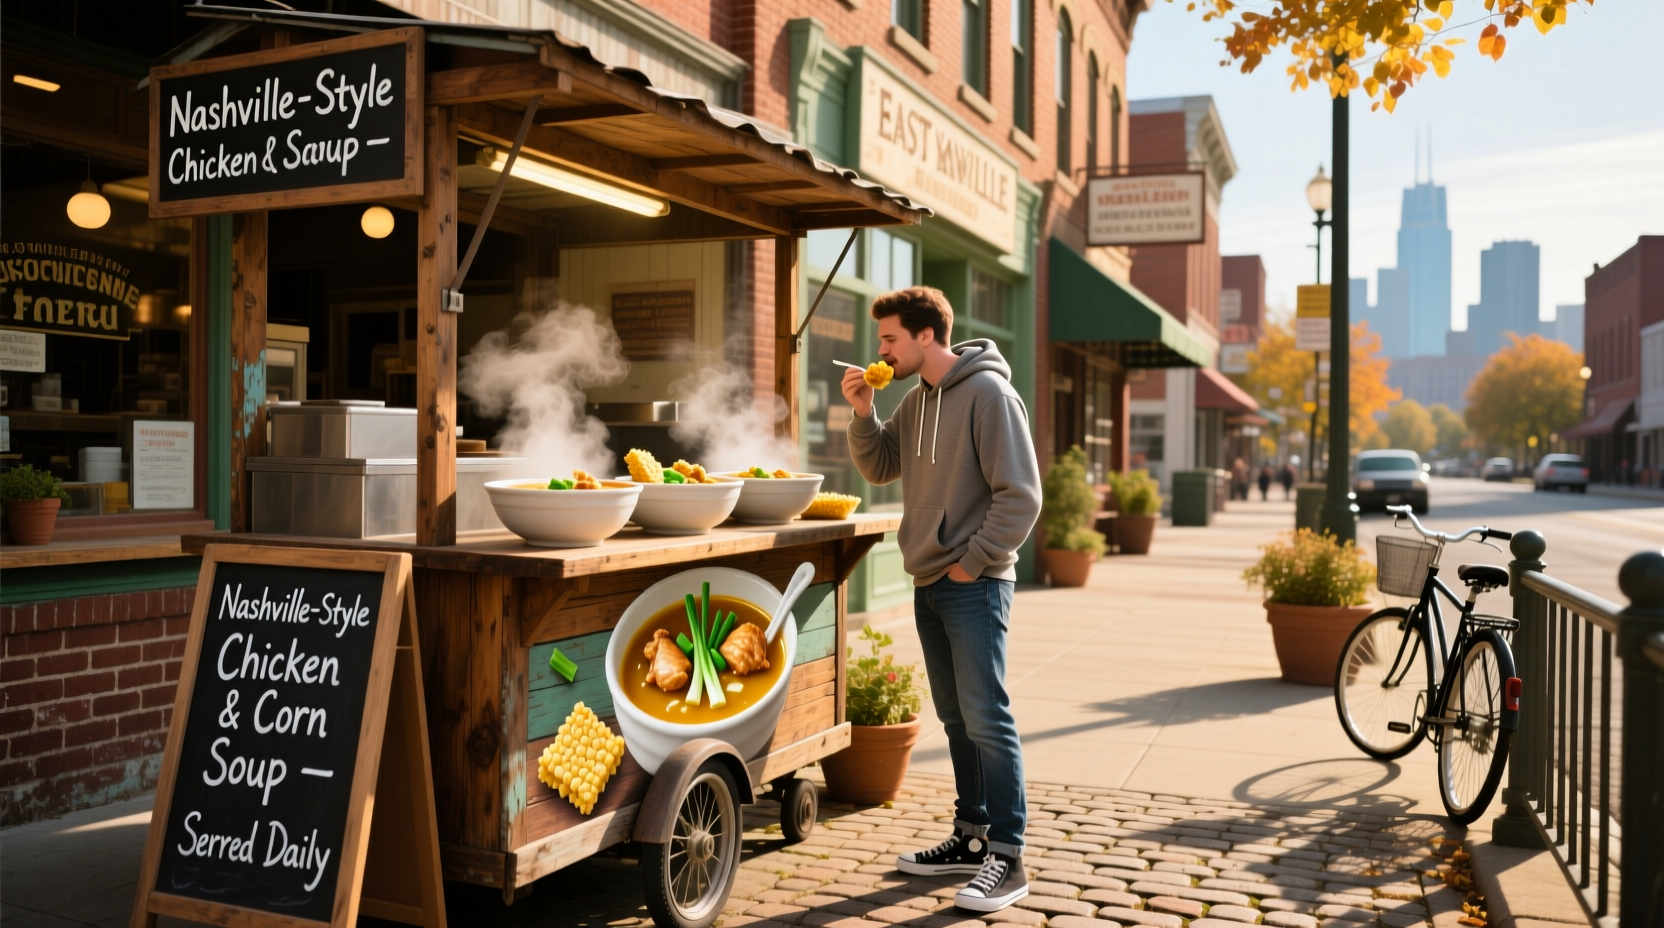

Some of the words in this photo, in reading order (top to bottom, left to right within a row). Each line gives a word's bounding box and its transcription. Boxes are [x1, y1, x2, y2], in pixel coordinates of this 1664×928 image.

[169, 63, 394, 138] Nashville-Style
[878, 87, 932, 163] EAST
[168, 143, 257, 185] Chicken
[261, 135, 278, 174] &
[218, 583, 370, 638] Nashville-Style
[217, 632, 340, 687] Chicken
[218, 689, 241, 730] &
[253, 688, 328, 738] Corn
[202, 736, 287, 806] Soup
[262, 819, 331, 892] Daily
